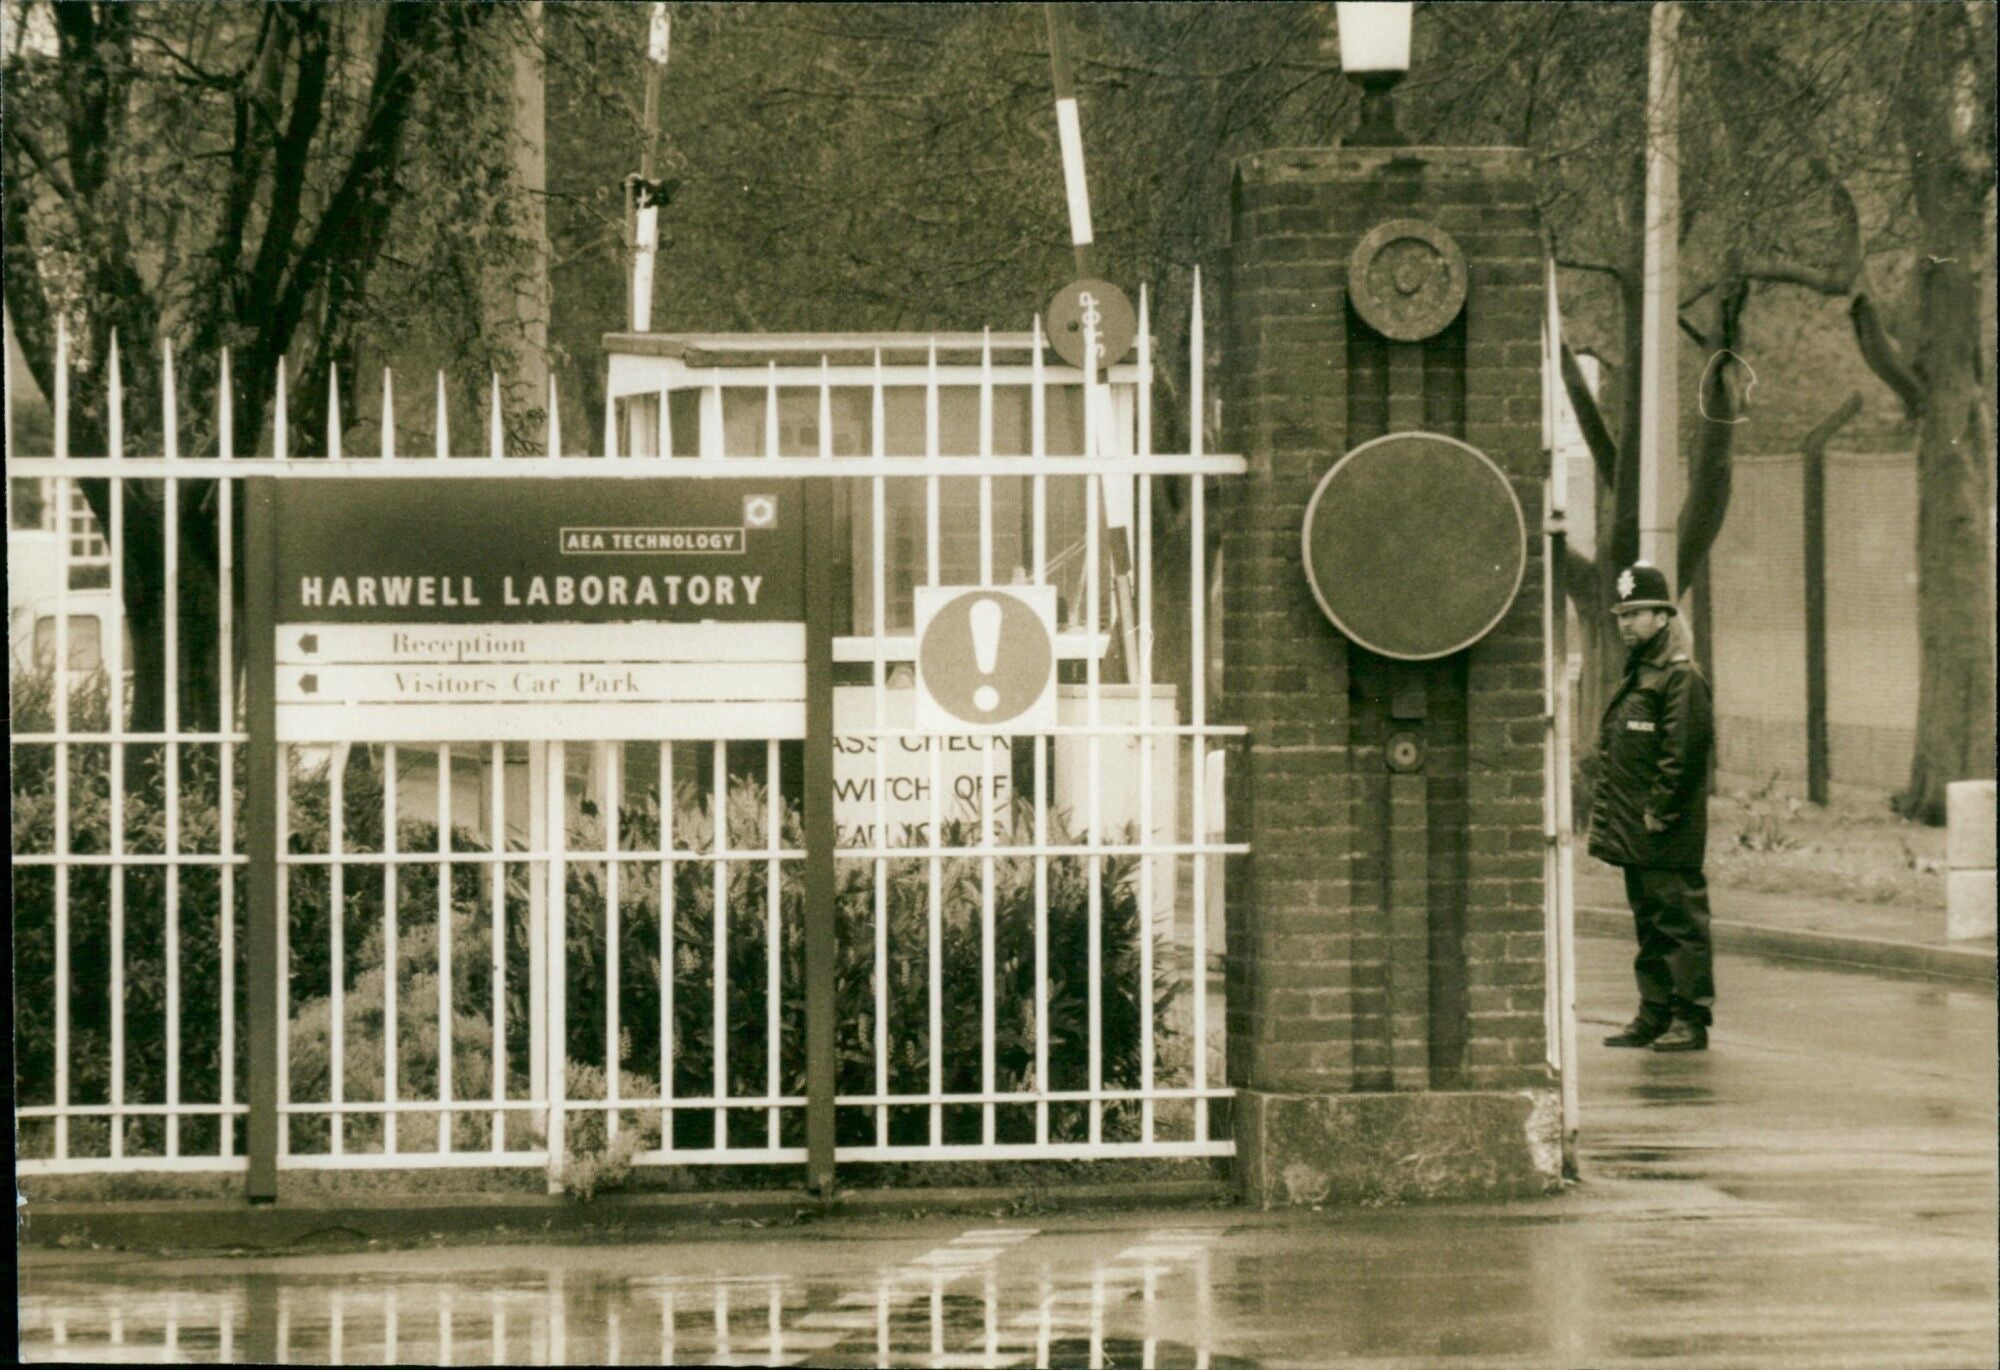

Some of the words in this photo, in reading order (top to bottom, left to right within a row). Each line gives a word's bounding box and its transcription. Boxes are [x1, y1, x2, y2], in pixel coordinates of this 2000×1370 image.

[567, 532, 604, 549] AEA
[612, 532, 735, 549] TECHNOLOGY
[301, 576, 482, 606] HARWELL
[503, 575, 764, 606] LABORATORY
[391, 632, 527, 661] Reception
[395, 671, 497, 693] Visitors
[512, 672, 560, 693] Car
[578, 671, 641, 693] Park
[833, 778, 930, 802] WICH
